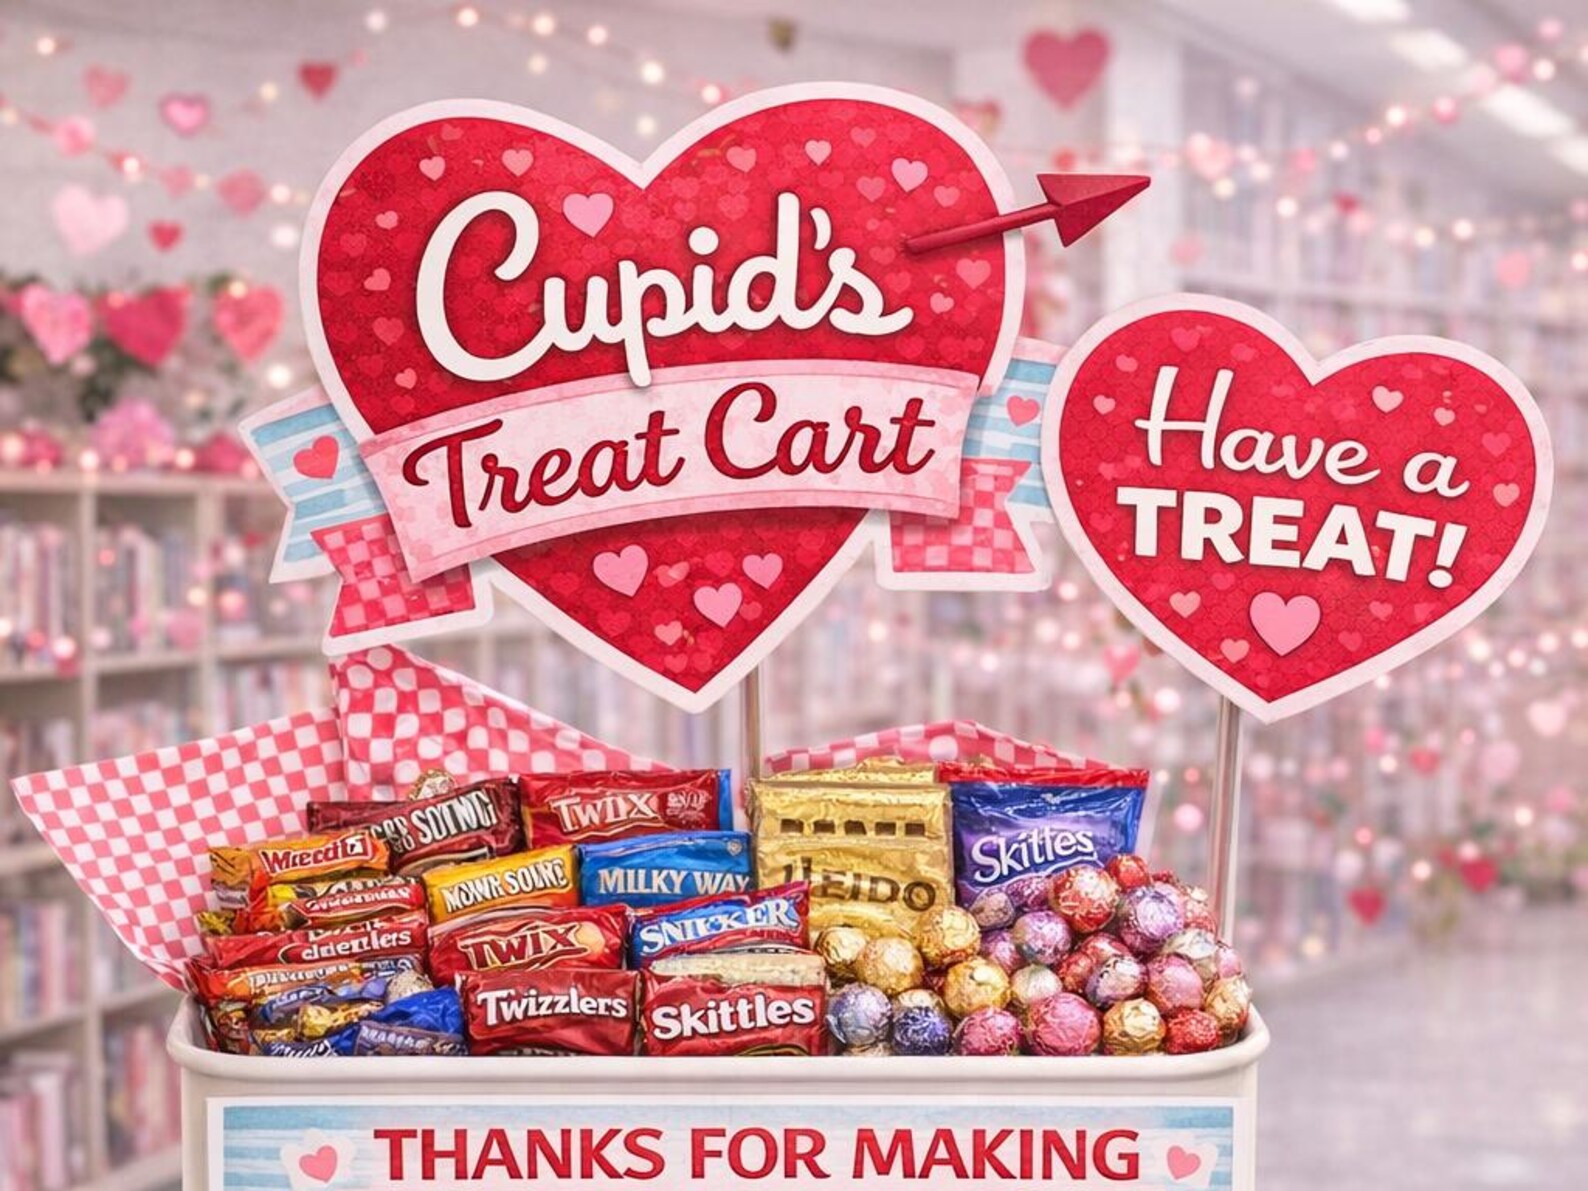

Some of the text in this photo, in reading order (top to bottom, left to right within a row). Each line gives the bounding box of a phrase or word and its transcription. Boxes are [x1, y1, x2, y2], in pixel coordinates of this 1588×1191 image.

[415, 191, 914, 388] Cupid's
[402, 381, 936, 530] Treat Cart
[1134, 365, 1470, 499] Have a
[1115, 486, 1468, 589] TREAT!
[598, 868, 750, 896] MILKY WAY
[477, 987, 628, 1027] Twizzlers
[652, 993, 815, 1040] Skittles
[374, 1127, 1140, 1182] THANKS FOR MAKING
